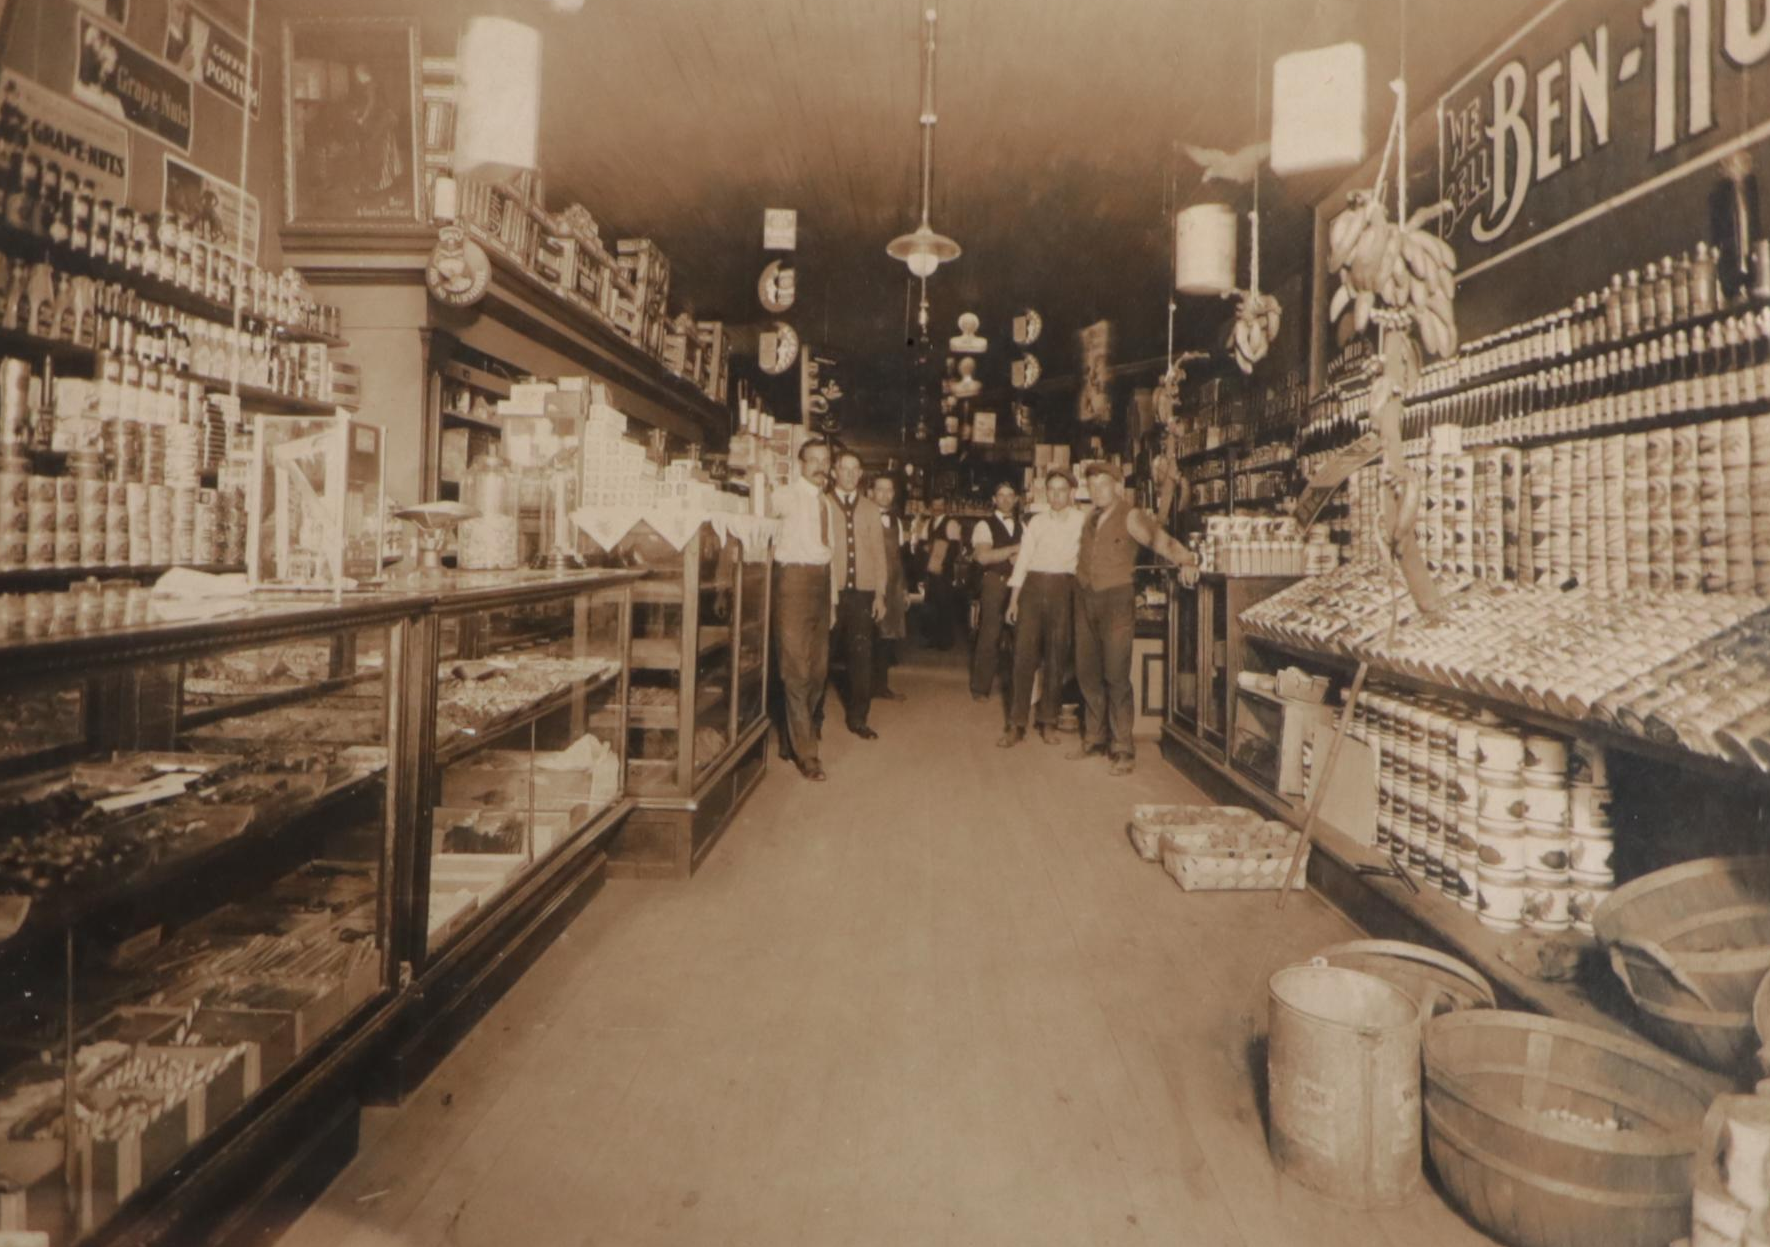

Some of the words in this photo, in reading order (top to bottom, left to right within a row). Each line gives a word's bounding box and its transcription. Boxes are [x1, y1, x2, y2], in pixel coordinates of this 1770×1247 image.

[205, 57, 258, 106] POSTUM
[212, 43, 252, 79] COFFE
[1446, 96, 1480, 172] WE
